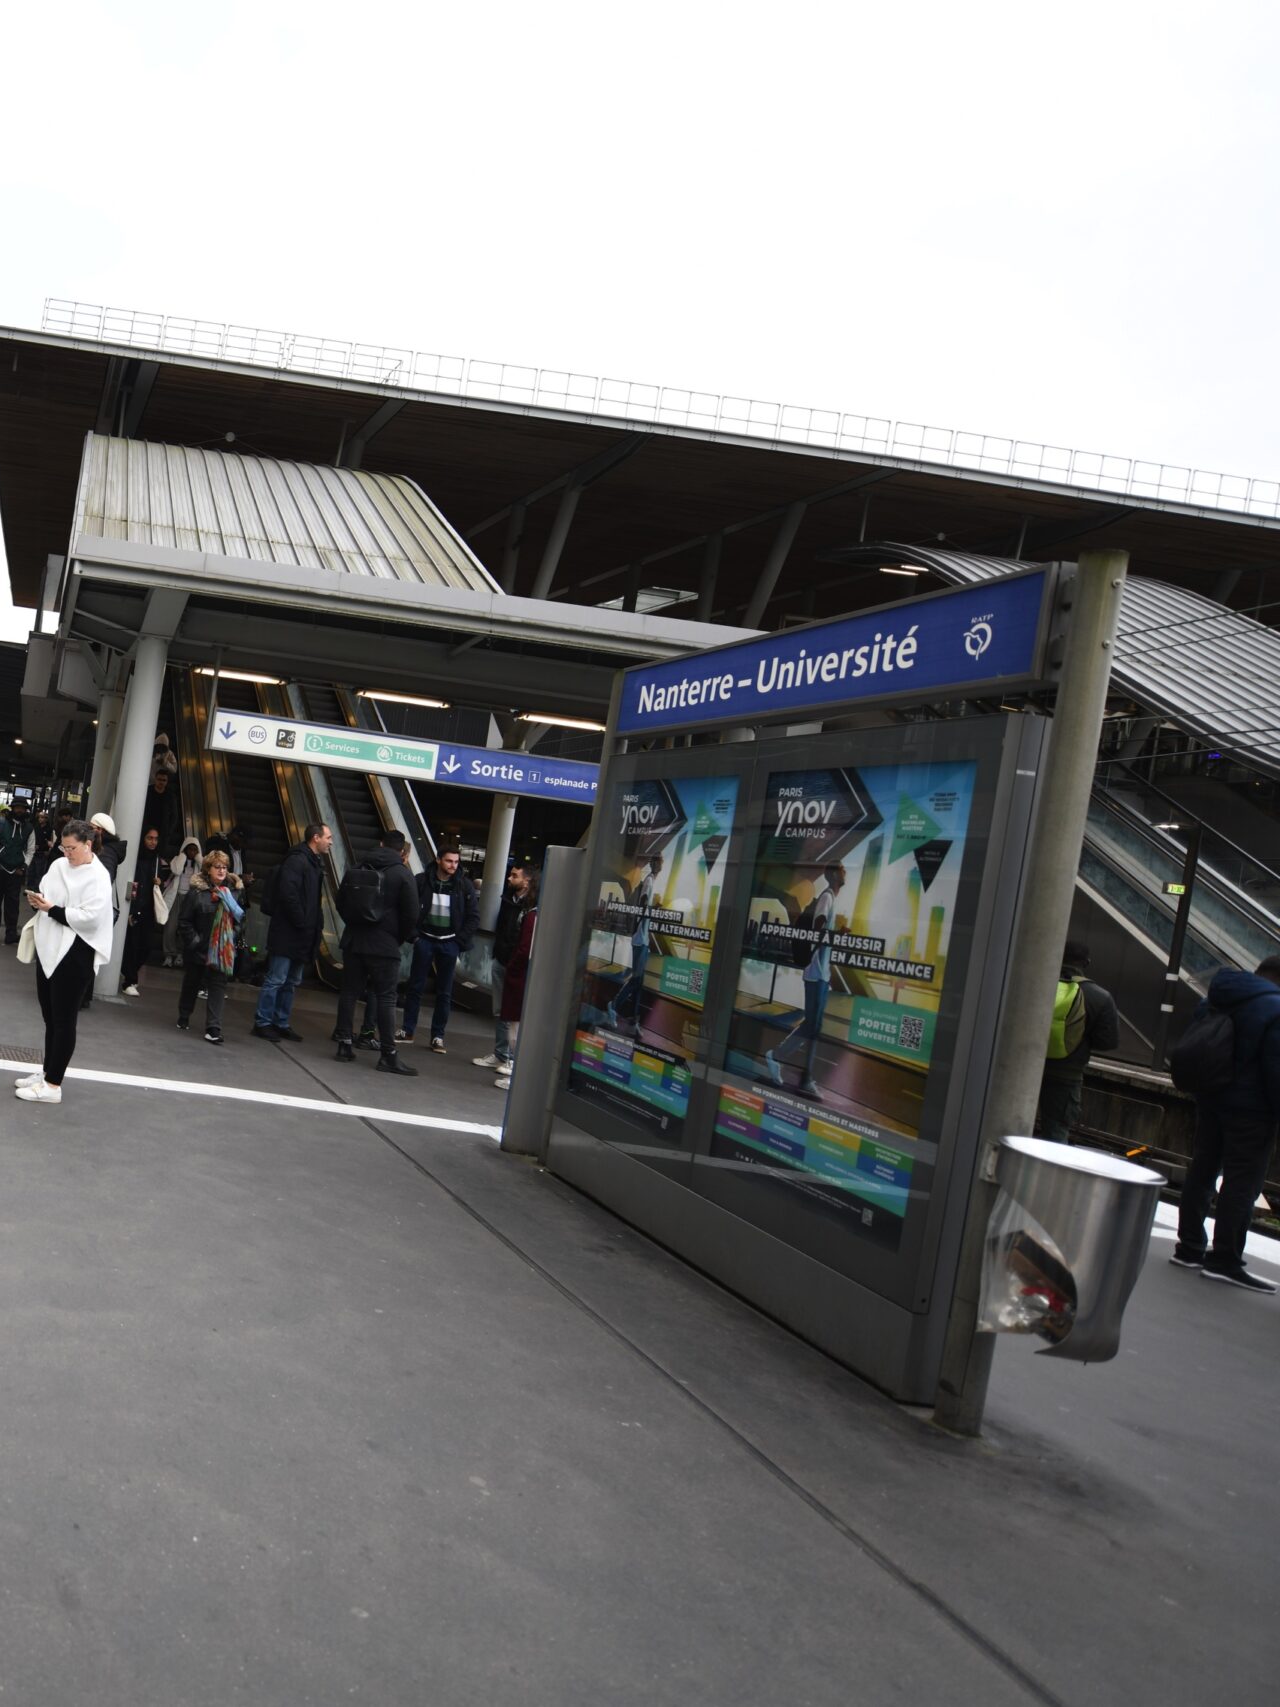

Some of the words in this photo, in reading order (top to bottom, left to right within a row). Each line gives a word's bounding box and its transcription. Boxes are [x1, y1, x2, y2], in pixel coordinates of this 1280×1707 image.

[971, 613, 994, 624] RATP
[250, 730, 266, 740] BUS
[325, 741, 360, 754] Services
[395, 751, 425, 764] Tickets
[470, 760, 524, 782] Sortie
[544, 775, 589, 790] esplanade
[623, 795, 640, 803] PARIS
[778, 787, 804, 797] PARIS
[774, 800, 837, 837] ynov
[785, 827, 827, 839] CAMPUS
[607, 902, 644, 916] APPRENDRE
[644, 907, 650, 917] À
[650, 908, 683, 923] RÉUSSIR
[649, 922, 658, 931] EN
[659, 923, 710, 941] ALTERNANCE
[760, 923, 820, 943] APPRENDRE
[821, 929, 831, 943] À
[833, 932, 883, 952] RÉUSSIR
[830, 950, 846, 962] EN
[848, 953, 932, 979] ALTERNANCE
[858, 1017, 898, 1034] PORTES
[857, 1029, 897, 1045] OUVERTES
